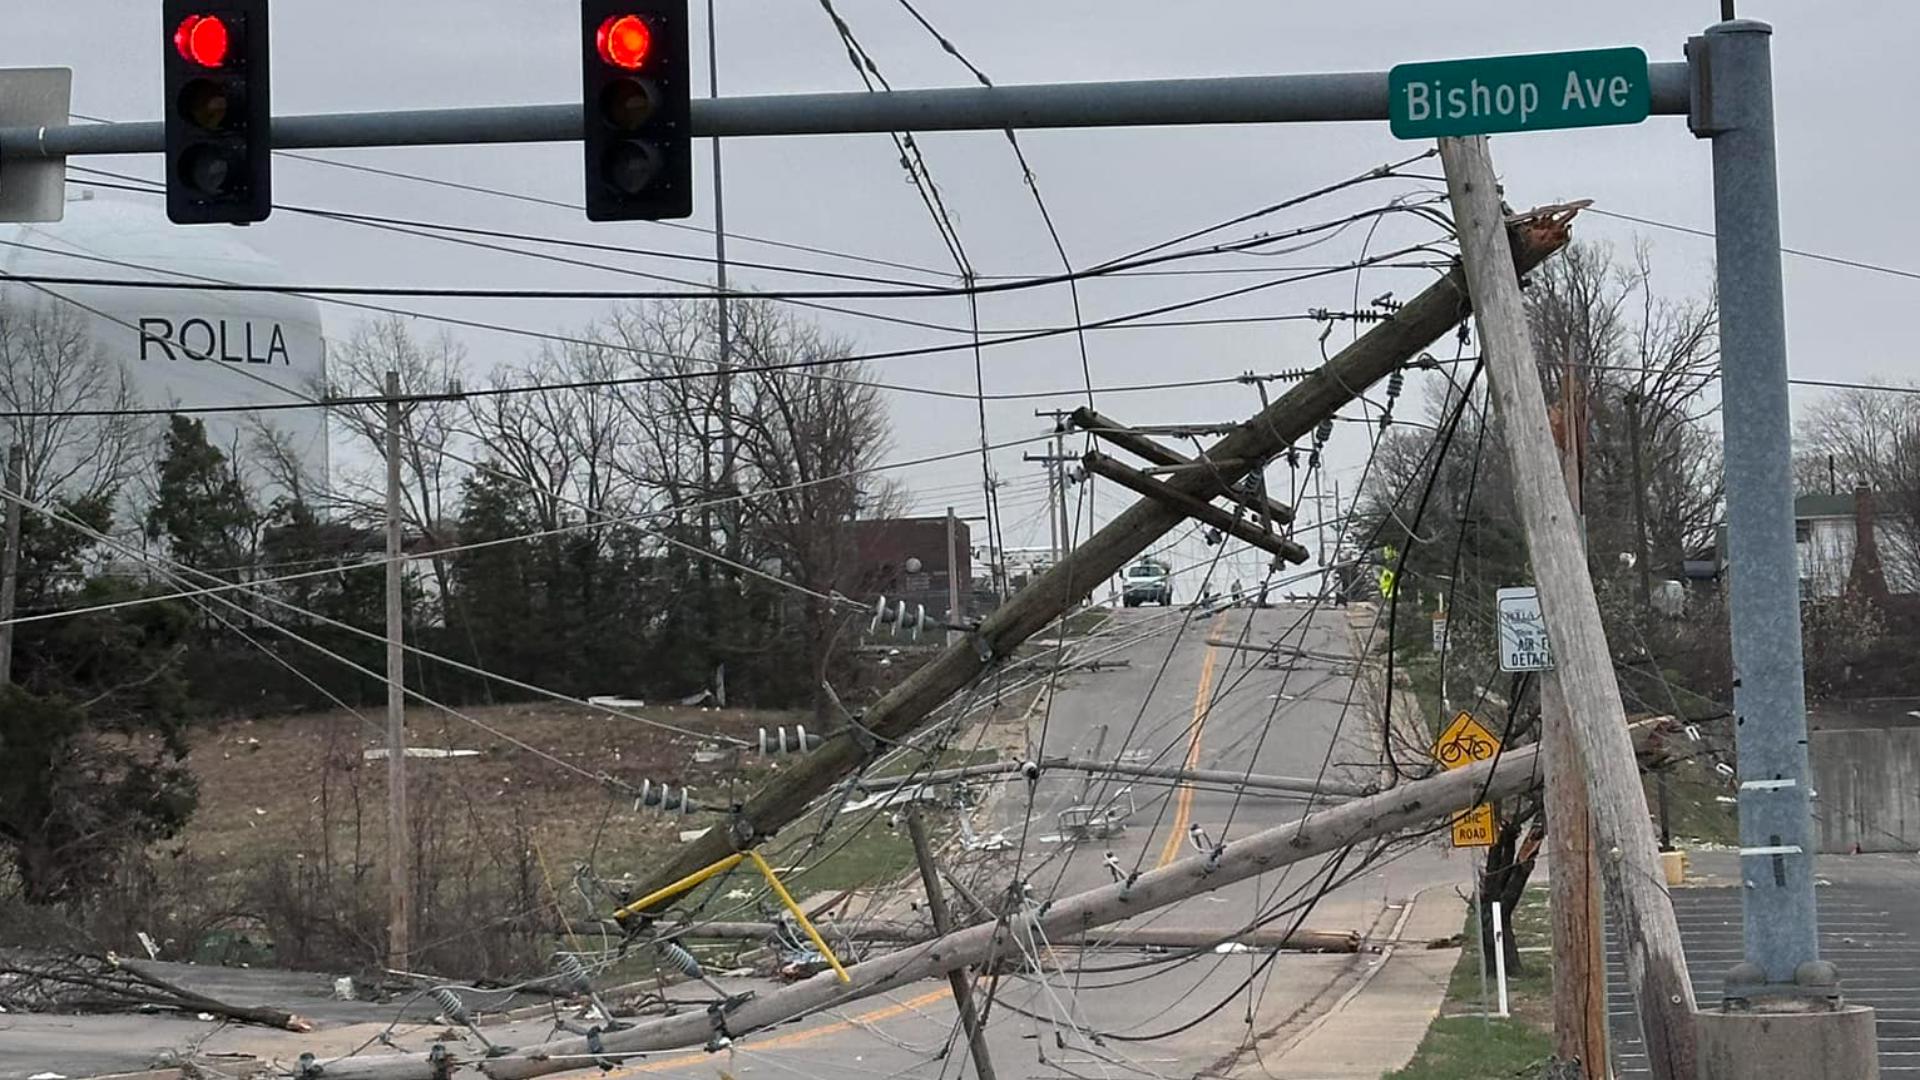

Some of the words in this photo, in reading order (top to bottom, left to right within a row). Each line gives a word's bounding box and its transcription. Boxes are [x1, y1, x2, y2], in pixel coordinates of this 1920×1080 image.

[1407, 78, 1539, 124] Bishop
[1561, 70, 1629, 111] Ave
[138, 317, 290, 366] ROLLA
[1517, 638, 1534, 651] AIR
[1459, 827, 1486, 840] ROAD
